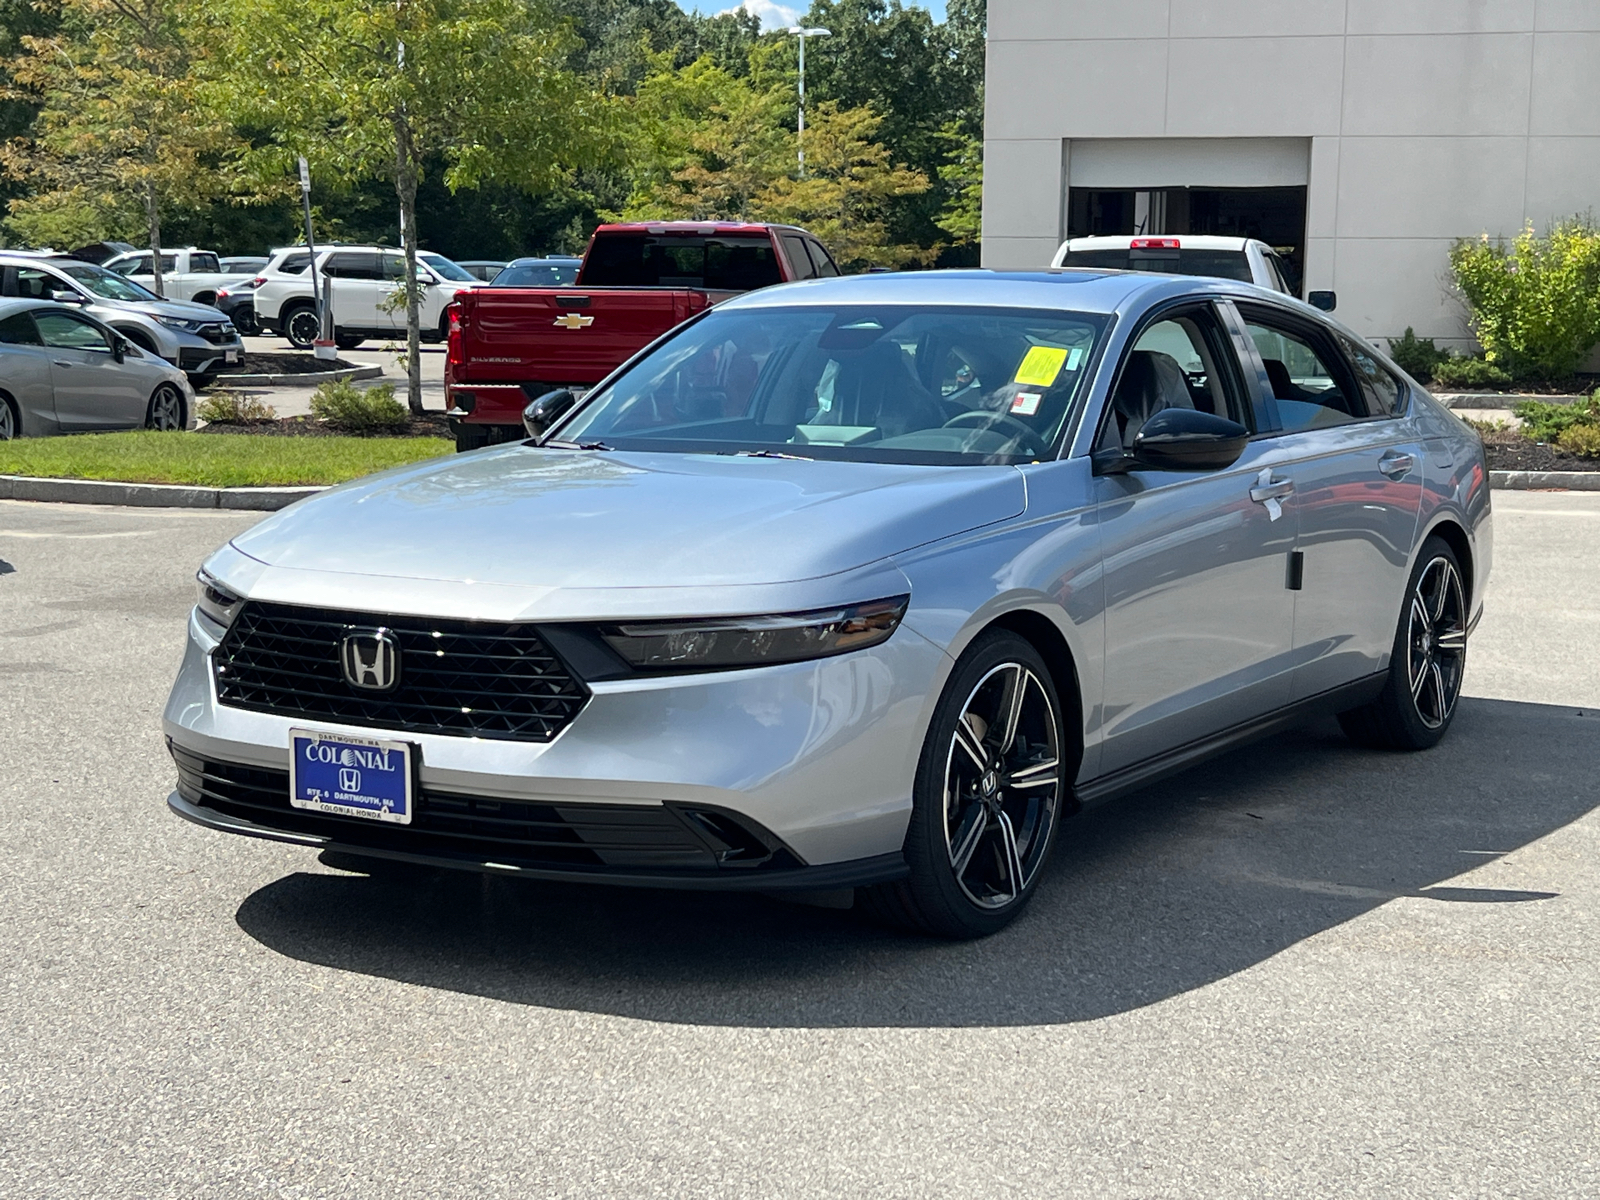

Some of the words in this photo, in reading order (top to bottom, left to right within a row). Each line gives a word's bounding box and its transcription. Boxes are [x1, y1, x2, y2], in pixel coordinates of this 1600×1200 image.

[305, 743, 395, 772] COLONIAL
[334, 792, 382, 807] DARTMOUTH,
[382, 798, 394, 807] MA
[320, 803, 355, 816] COLONIAL
[356, 810, 382, 819] HONDA
